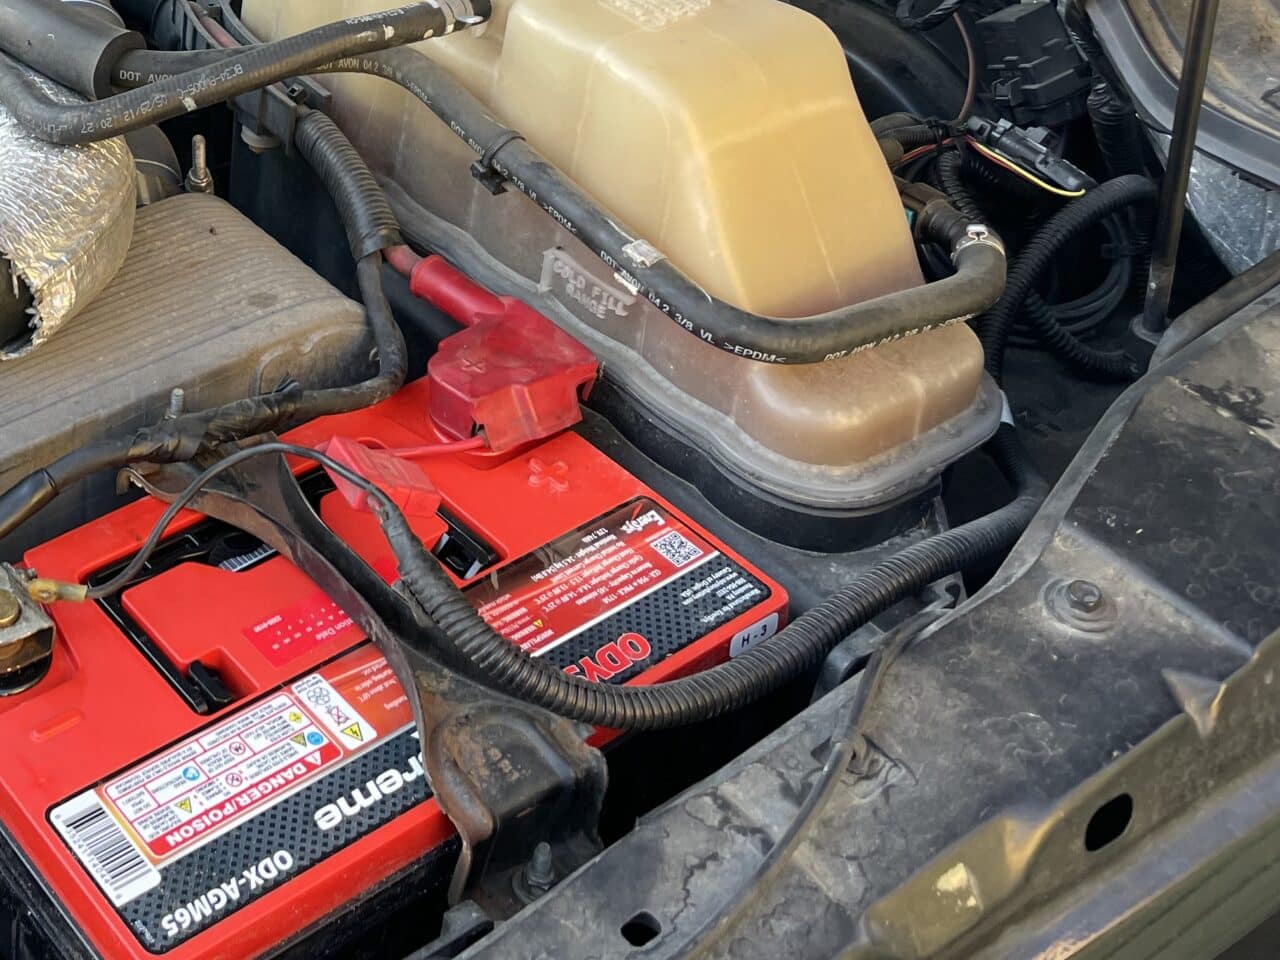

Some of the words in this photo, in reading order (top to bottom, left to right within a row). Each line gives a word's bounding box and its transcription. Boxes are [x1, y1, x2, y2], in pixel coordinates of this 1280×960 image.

[120, 69, 141, 82] DOT
[338, 58, 360, 70] AVON
[552, 259, 587, 290] COLD
[591, 287, 630, 318] FILL
[600, 250, 618, 269] DOT
[661, 303, 671, 314] 2
[674, 312, 693, 330] 3/8
[700, 328, 716, 344] VL
[166, 763, 307, 847] DANGER/POISON
[313, 756, 424, 831] reme
[161, 850, 293, 937] ODX-AGM65
